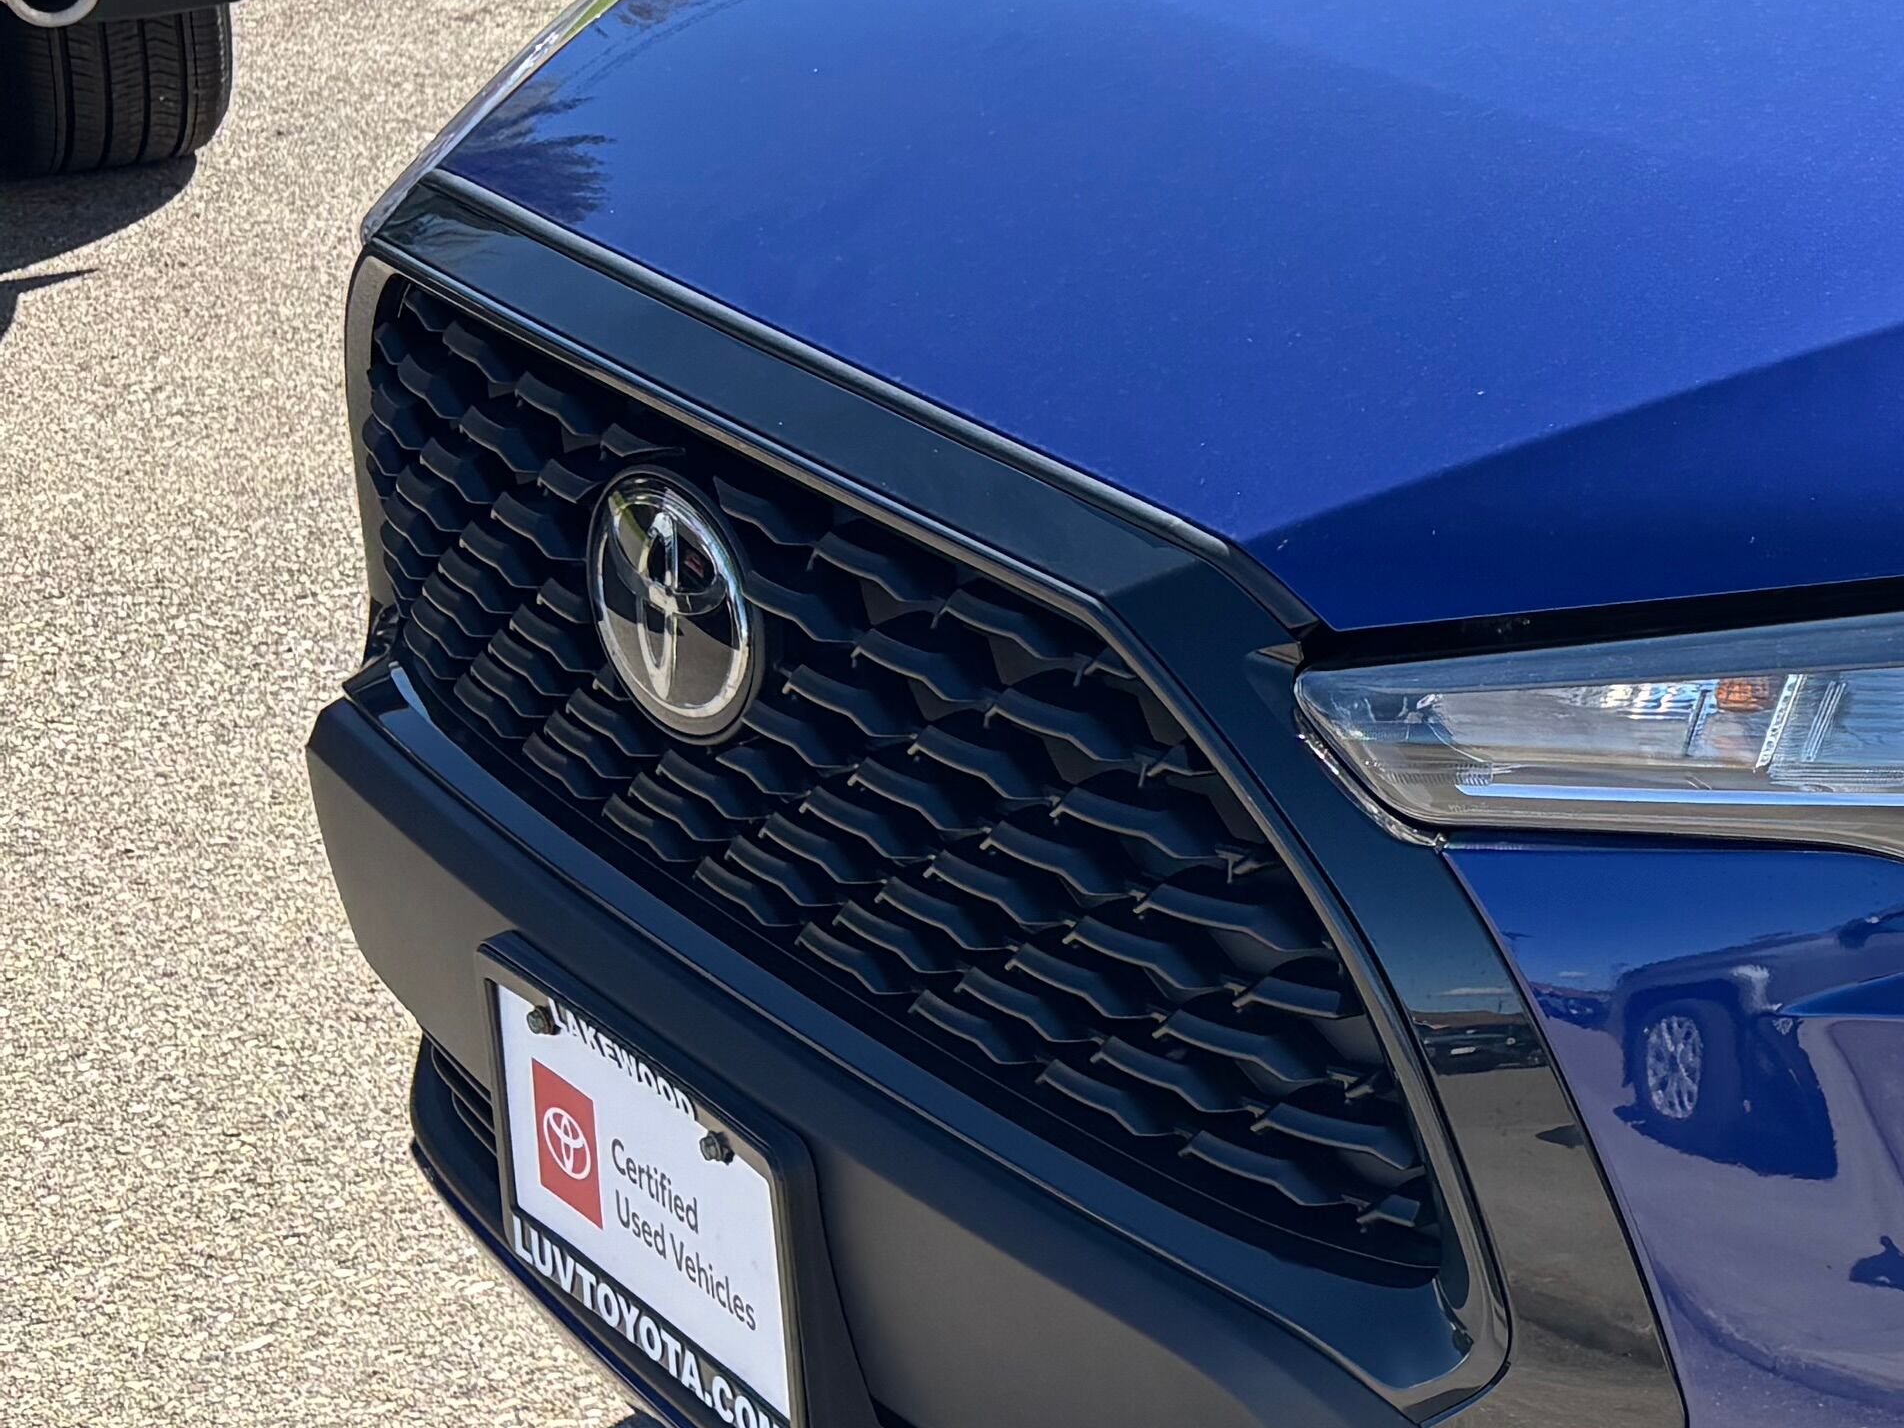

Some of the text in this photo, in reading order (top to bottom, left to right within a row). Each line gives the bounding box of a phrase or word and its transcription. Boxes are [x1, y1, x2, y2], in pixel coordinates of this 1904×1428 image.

[548, 996, 698, 1122] LAKEWOOD
[610, 1137, 699, 1236] Certified
[614, 1189, 757, 1332] Used Vehicles
